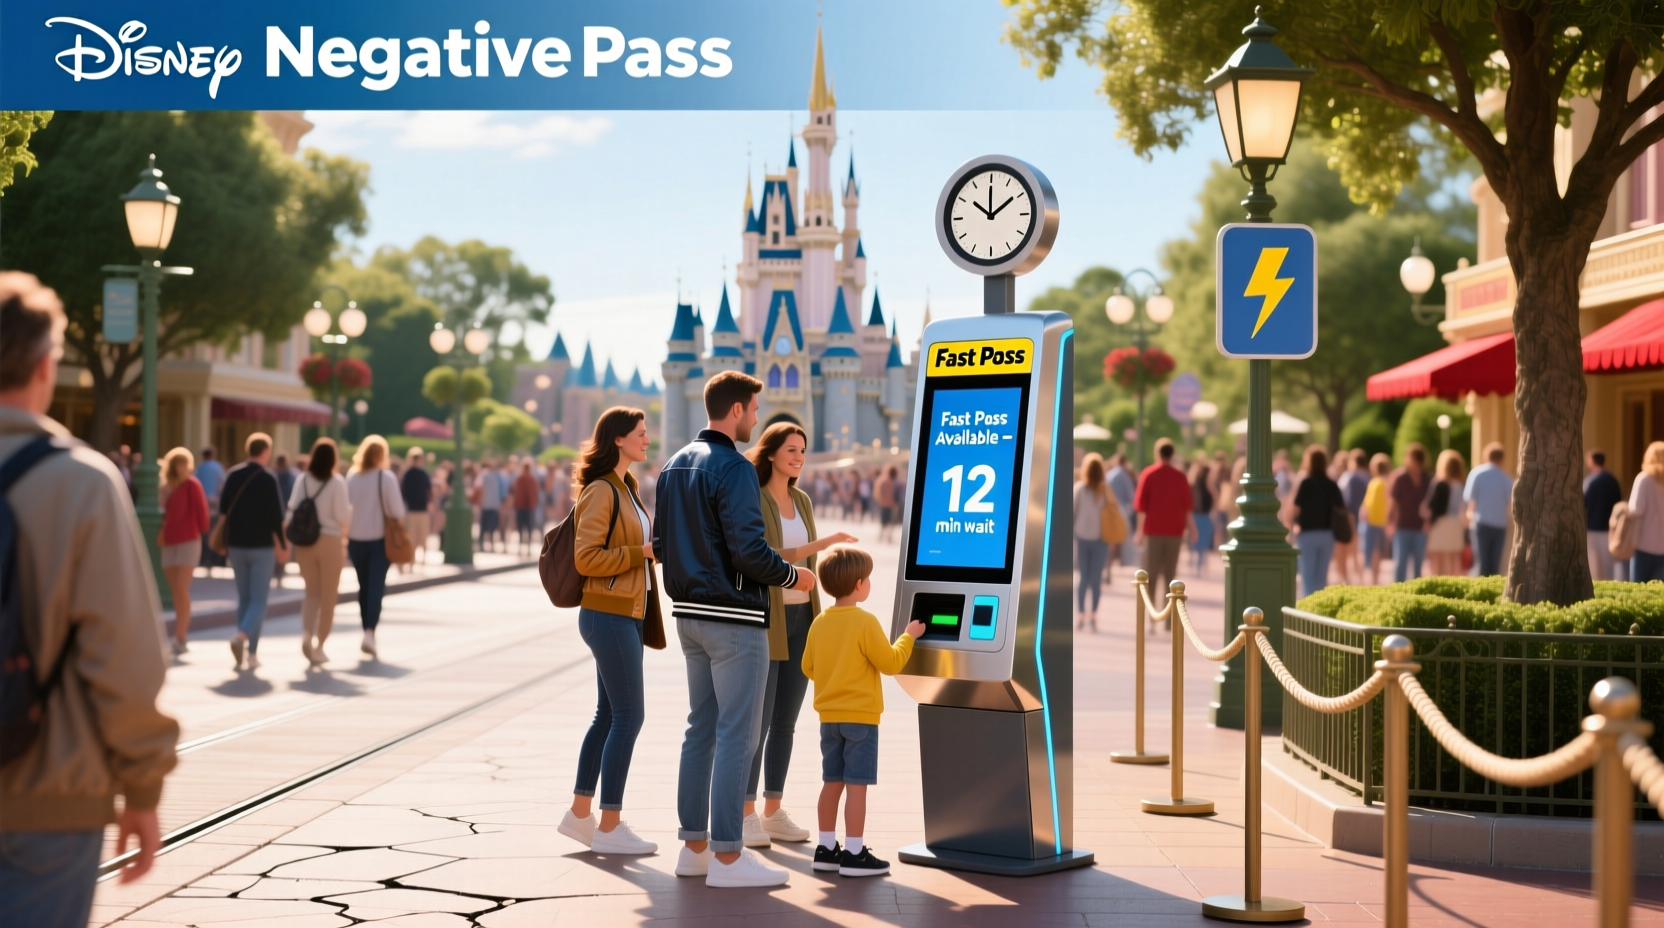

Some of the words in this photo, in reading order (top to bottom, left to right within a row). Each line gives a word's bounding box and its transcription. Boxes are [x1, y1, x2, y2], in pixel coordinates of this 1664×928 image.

[935, 347, 976, 368] Fast
[941, 411, 971, 427] Fast
[942, 464, 996, 513] 12
[935, 517, 961, 533] min
[964, 518, 995, 534] wait
